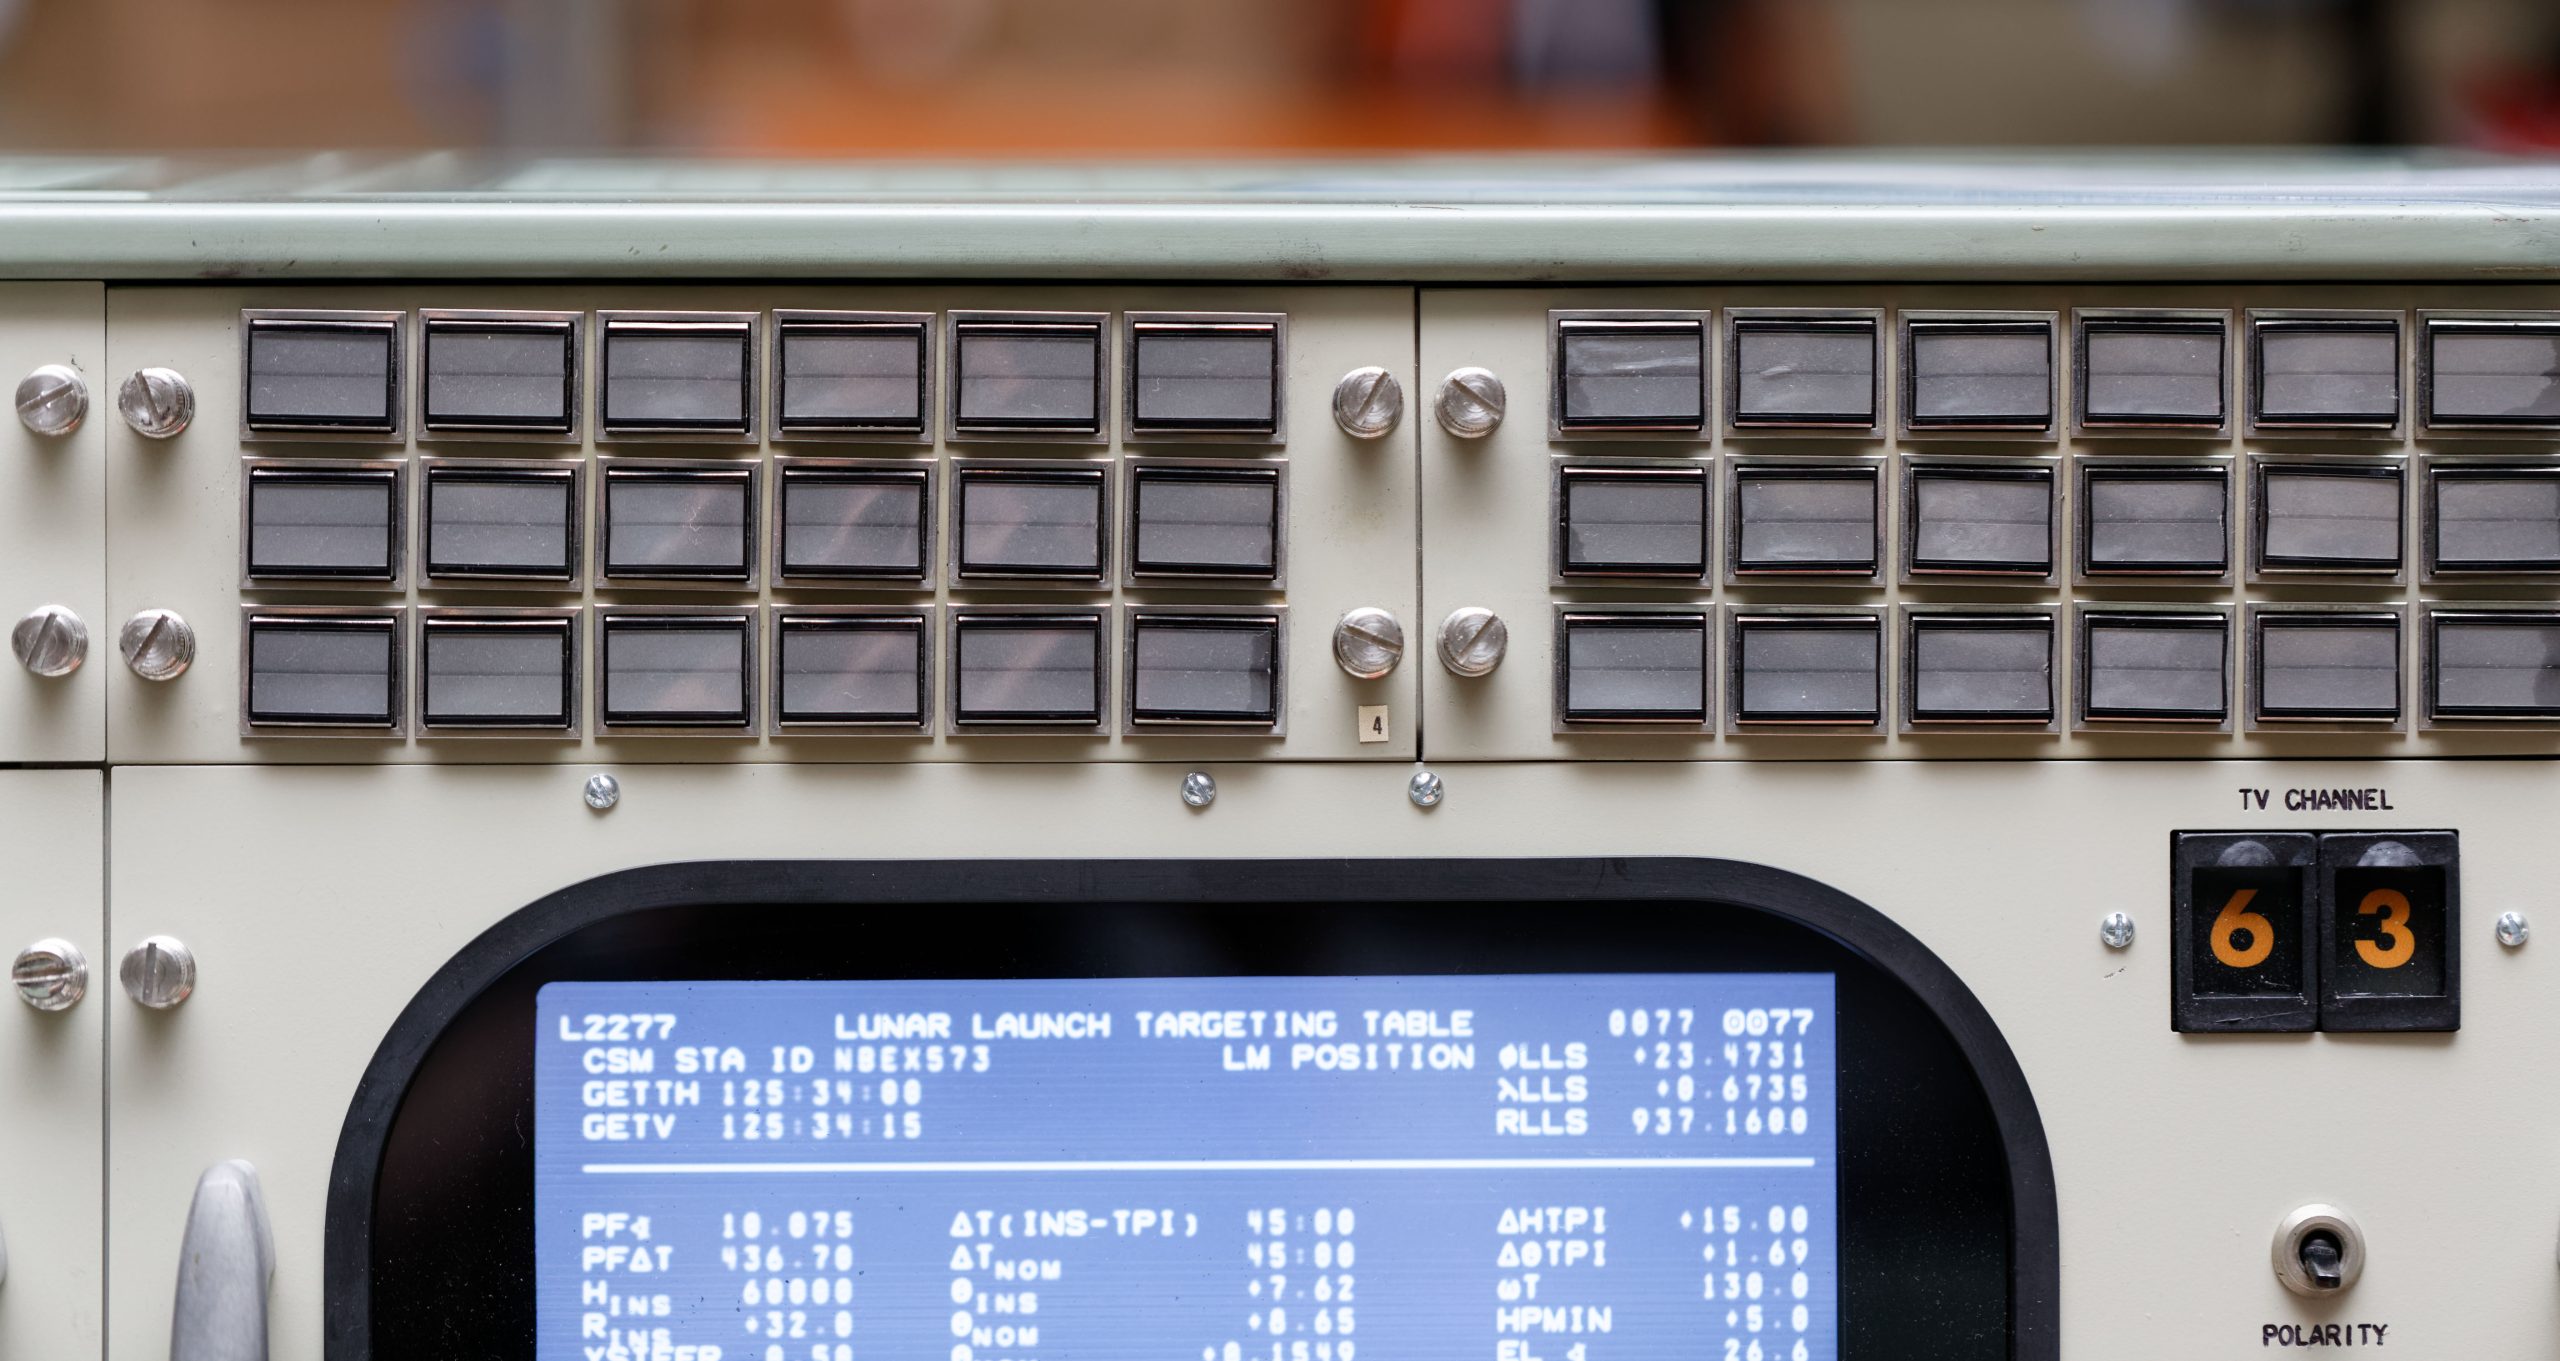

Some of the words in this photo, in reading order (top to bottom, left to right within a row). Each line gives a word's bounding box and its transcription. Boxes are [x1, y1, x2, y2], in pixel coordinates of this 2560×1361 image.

[1373, 715, 1382, 735] 4
[2239, 789, 2269, 810] TV
[2285, 789, 2394, 811] CHANNEL
[2210, 889, 2274, 968] 6
[2354, 889, 2415, 969] 3
[560, 1014, 676, 1041] L2277
[835, 1013, 950, 1039] LUNAR
[973, 1012, 1110, 1039] LAUNCH
[1136, 1011, 1337, 1038] TARGETING
[1363, 1010, 1473, 1037] TABLE
[1609, 1009, 1693, 1036] 0077
[1723, 1009, 1813, 1035] 0077
[583, 1048, 653, 1074] CSM
[675, 1047, 745, 1073] STA
[773, 1046, 814, 1073] ID
[1223, 1045, 1270, 1071] LM
[1292, 1044, 1475, 1070] POSITION
[583, 1080, 699, 1107] GETTH
[723, 1079, 921, 1106] 125:34:00
[583, 1113, 675, 1140] GETV
[723, 1111, 921, 1140] 125:34:15
[1496, 1108, 1588, 1136] RLLS
[1632, 1107, 1807, 1135] 937.1600
[723, 1211, 853, 1239] 10.075
[1247, 1208, 1355, 1236] 45:00
[721, 1244, 853, 1272] 436.70
[1247, 1241, 1355, 1269] 45:00
[742, 1277, 853, 1306] 60000
[1704, 1272, 1808, 1300] 130.0
[1496, 1305, 1612, 1333] HPMIN
[2263, 1323, 2388, 1347] POLARITY
